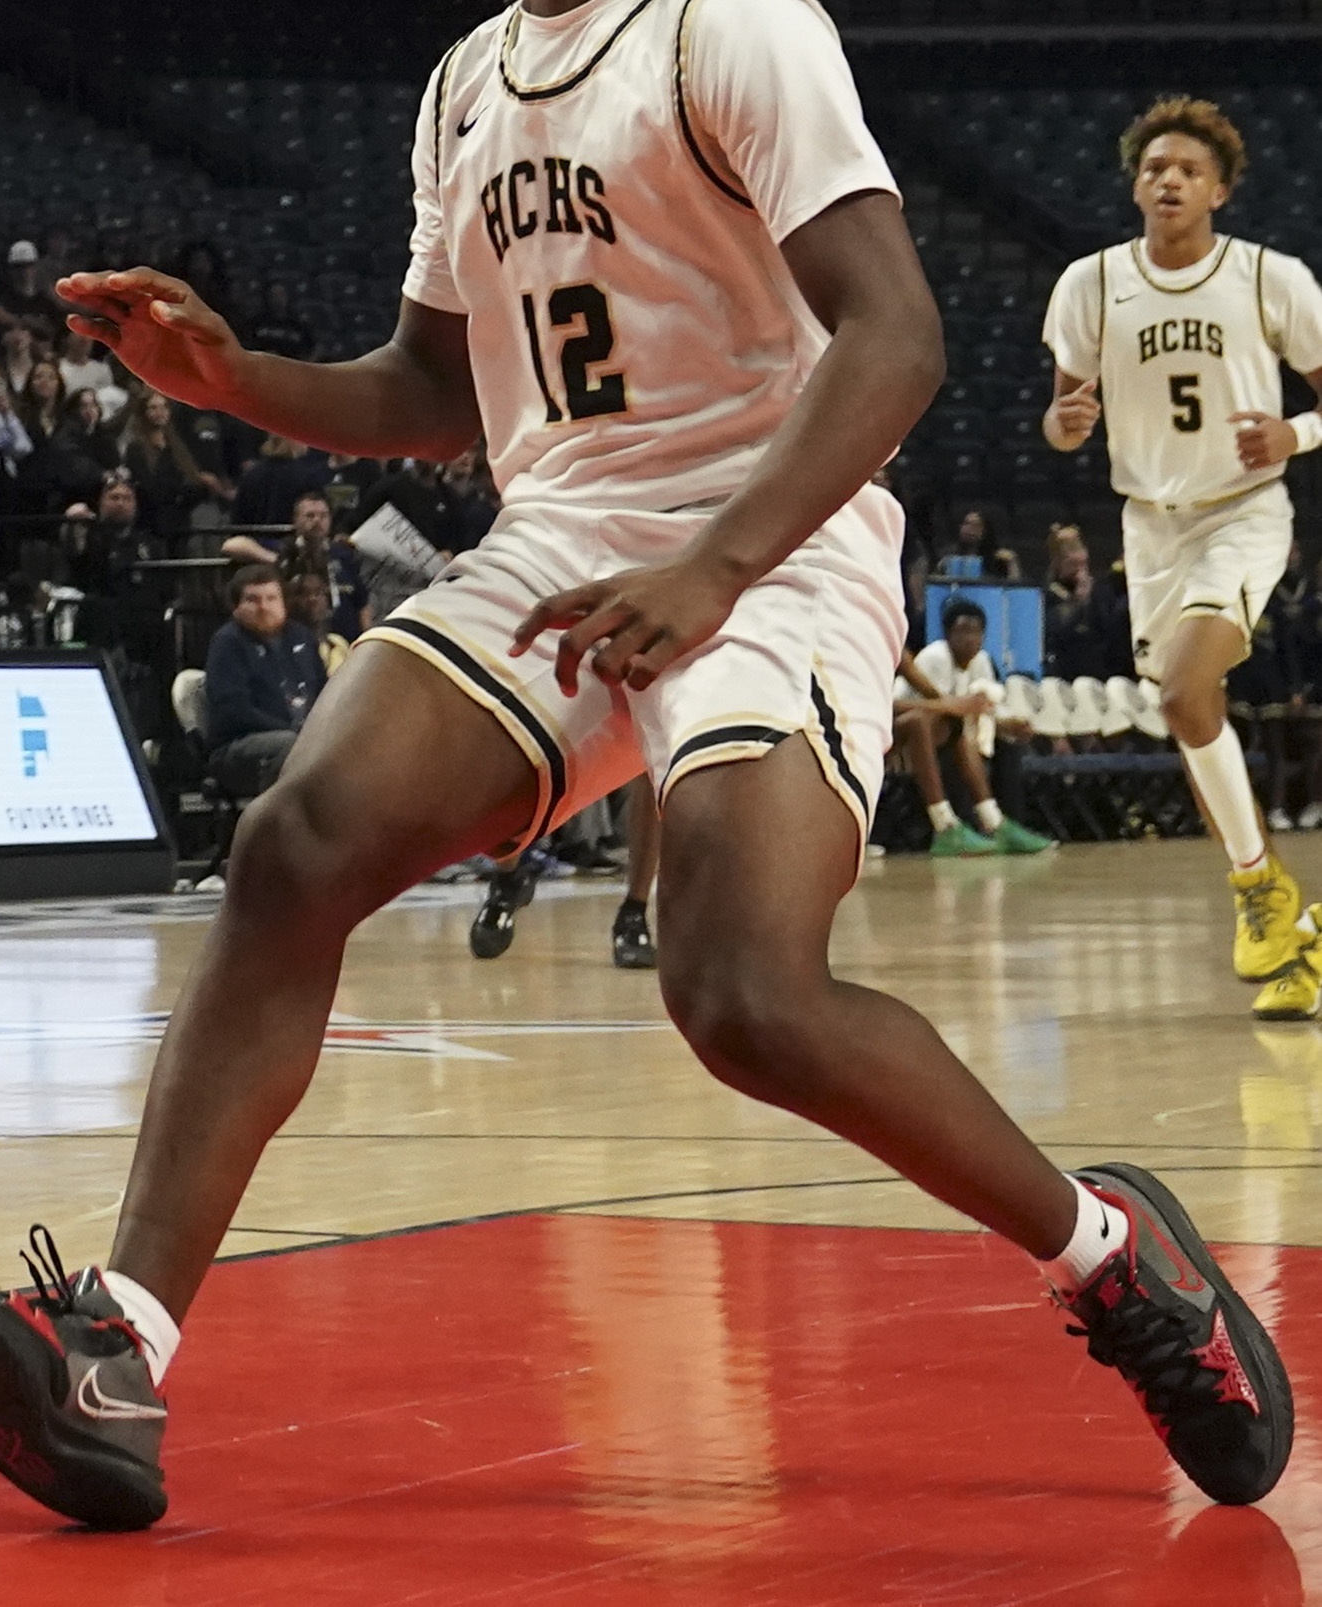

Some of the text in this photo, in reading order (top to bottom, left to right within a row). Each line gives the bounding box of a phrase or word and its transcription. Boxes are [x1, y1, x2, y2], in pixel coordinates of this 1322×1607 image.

[481, 156, 617, 264] HCHS
[520, 282, 628, 423] 12
[1137, 318, 1224, 364] HCHS
[1168, 373, 1203, 432] 5
